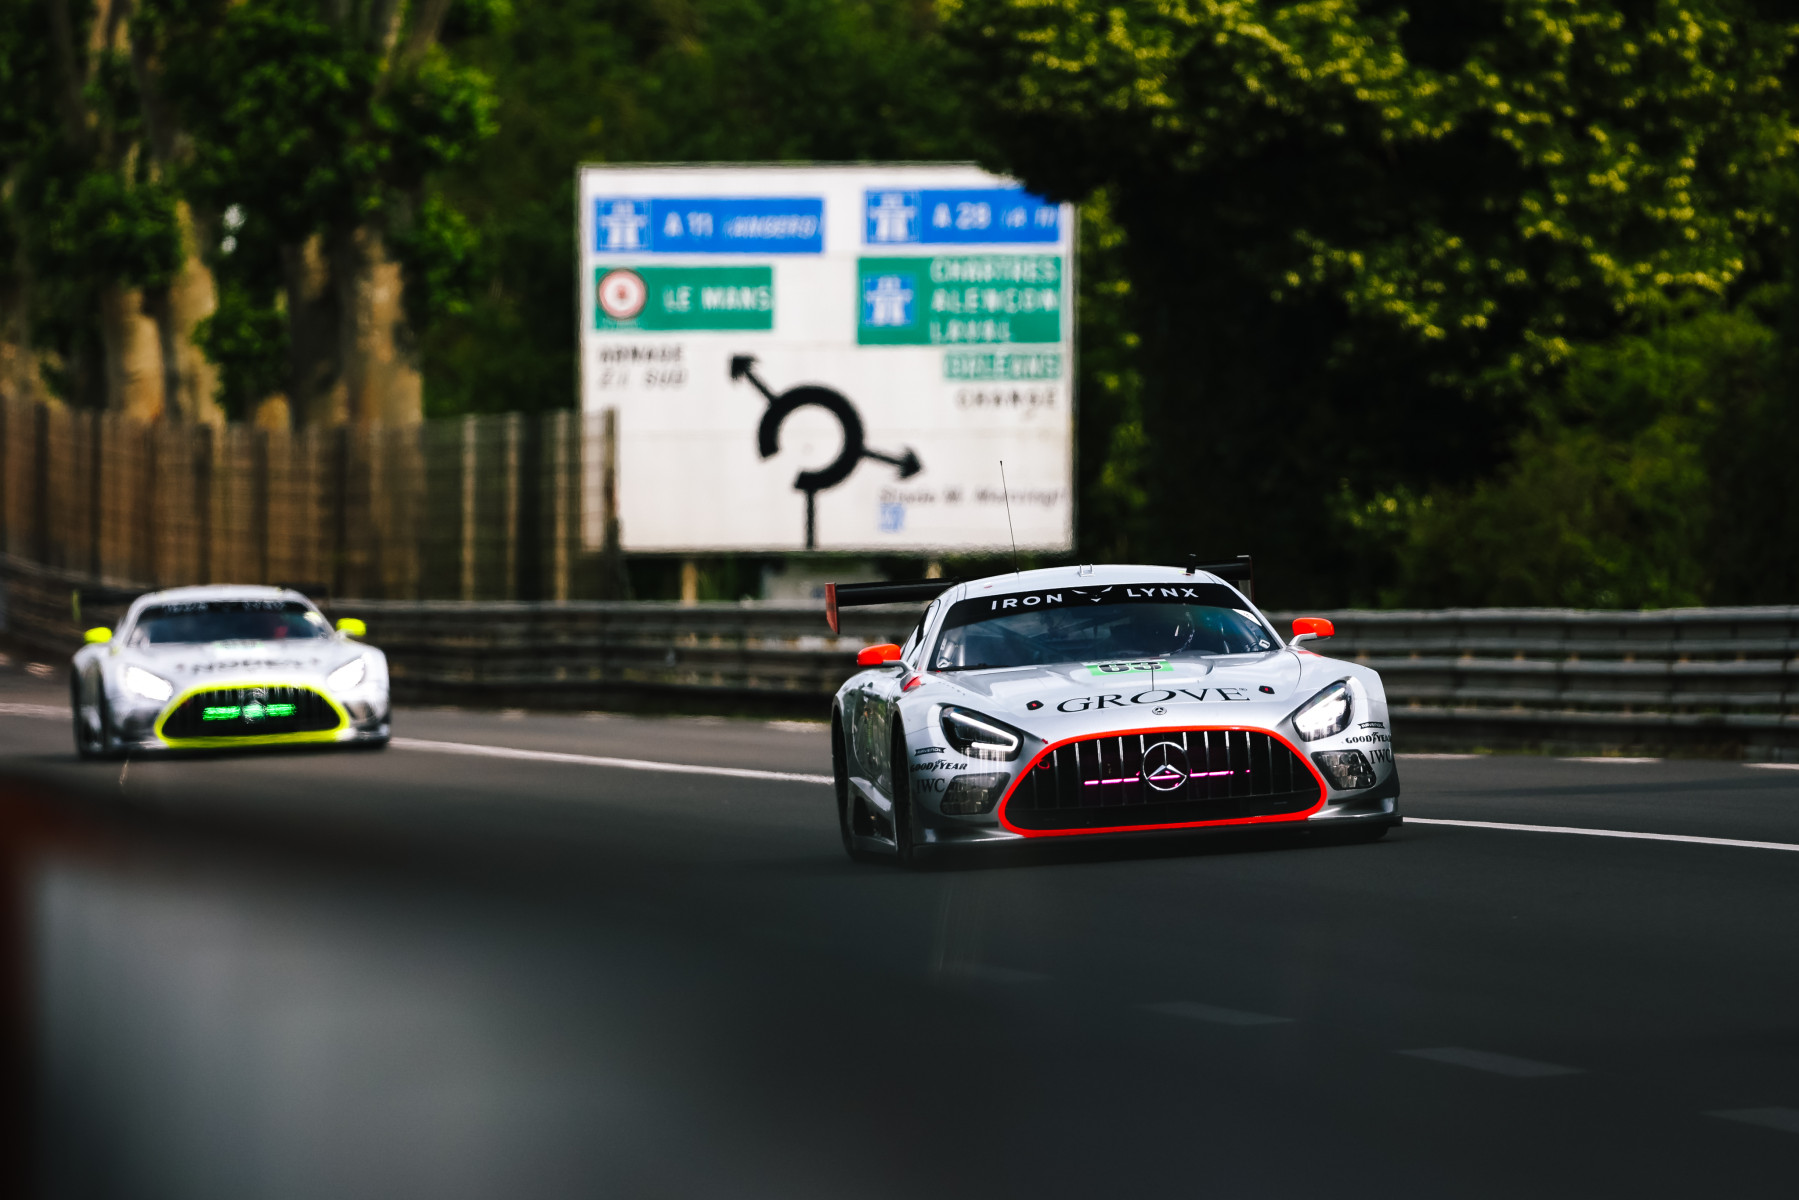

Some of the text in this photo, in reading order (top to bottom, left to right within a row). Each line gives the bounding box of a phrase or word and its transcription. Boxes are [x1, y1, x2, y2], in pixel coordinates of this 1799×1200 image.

[663, 211, 684, 237] A
[687, 211, 713, 238] 11
[933, 203, 952, 228] A
[662, 285, 773, 312] LE MANS
[991, 587, 1199, 611] IRON LYNX
[1098, 661, 1162, 673] 63
[910, 759, 968, 773] GOODYEAR
[917, 778, 945, 793] IWC
